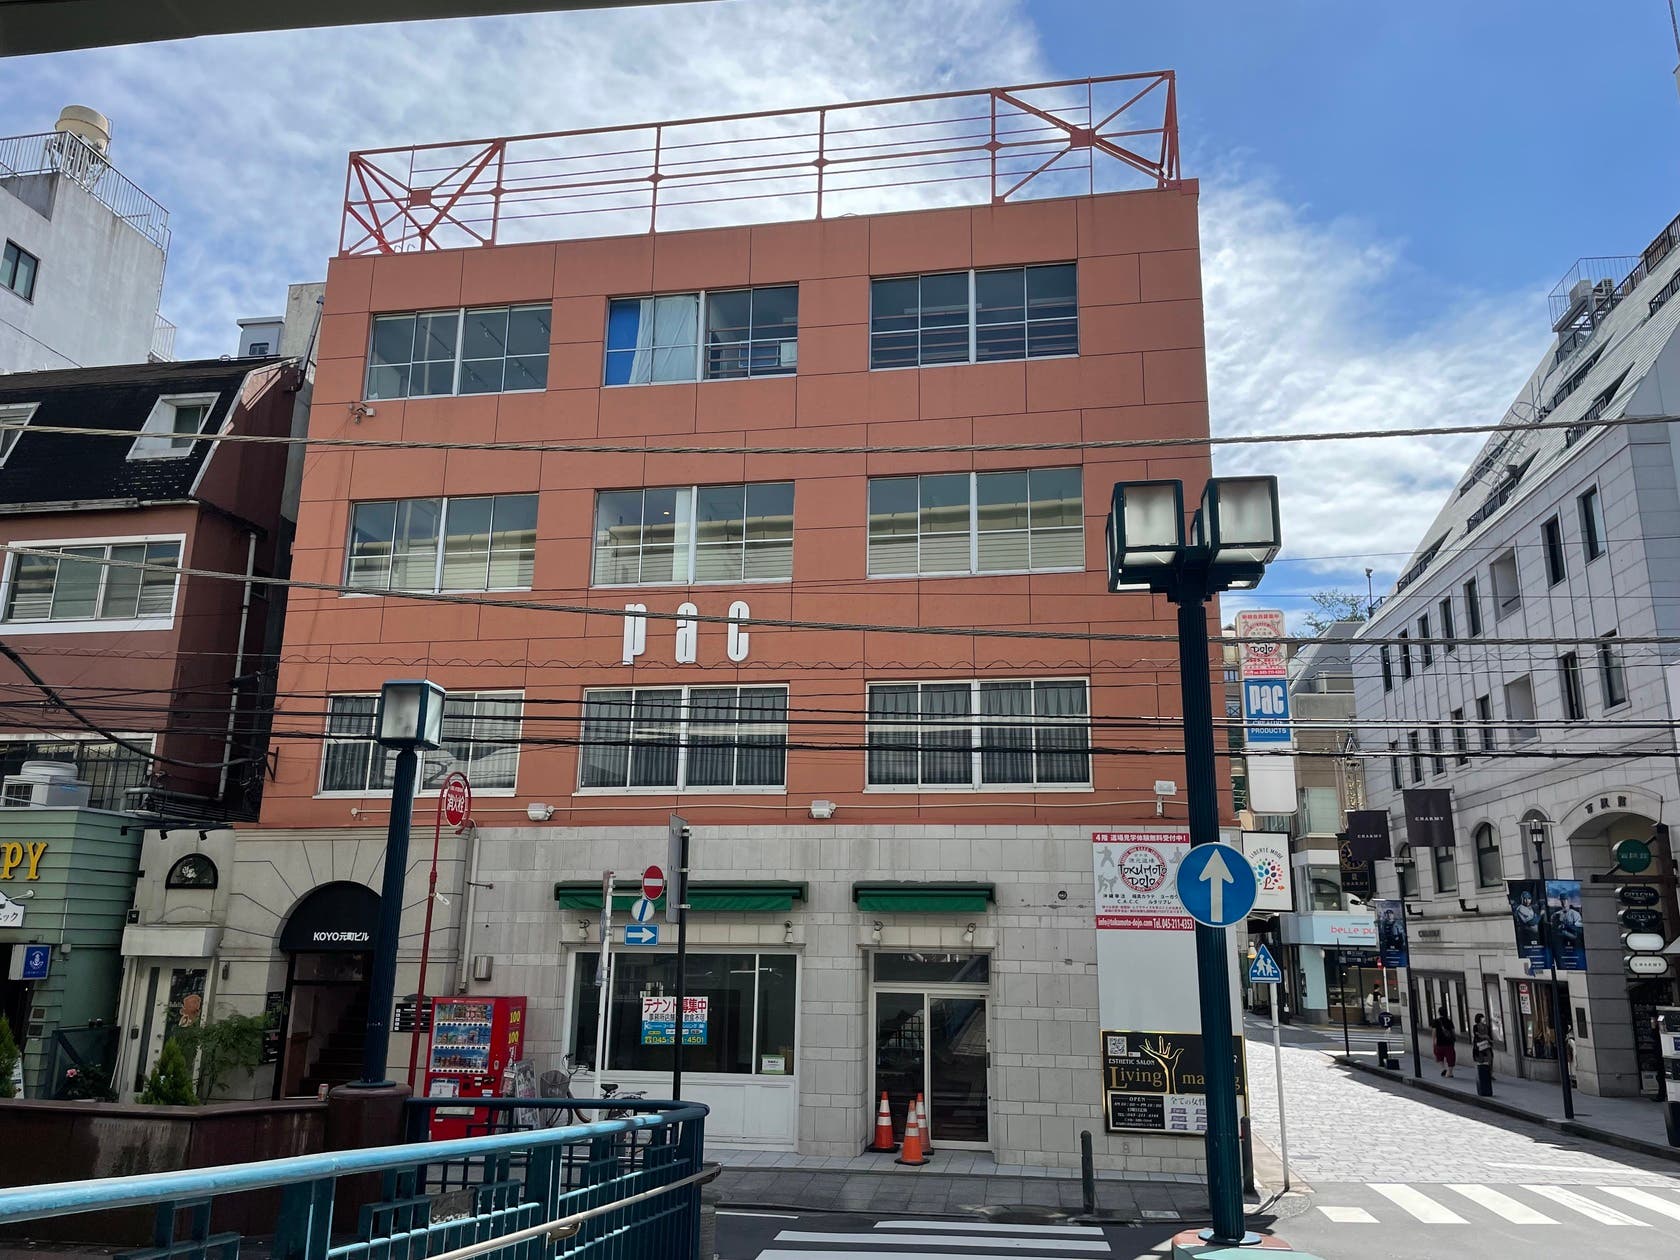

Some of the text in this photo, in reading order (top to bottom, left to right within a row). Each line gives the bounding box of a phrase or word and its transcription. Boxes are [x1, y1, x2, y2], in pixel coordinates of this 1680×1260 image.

[622, 600, 750, 666] pac
[1248, 685, 1284, 715] pac
[1251, 727, 1288, 735] PRODUCTS
[1109, 1066, 1162, 1089] Living
